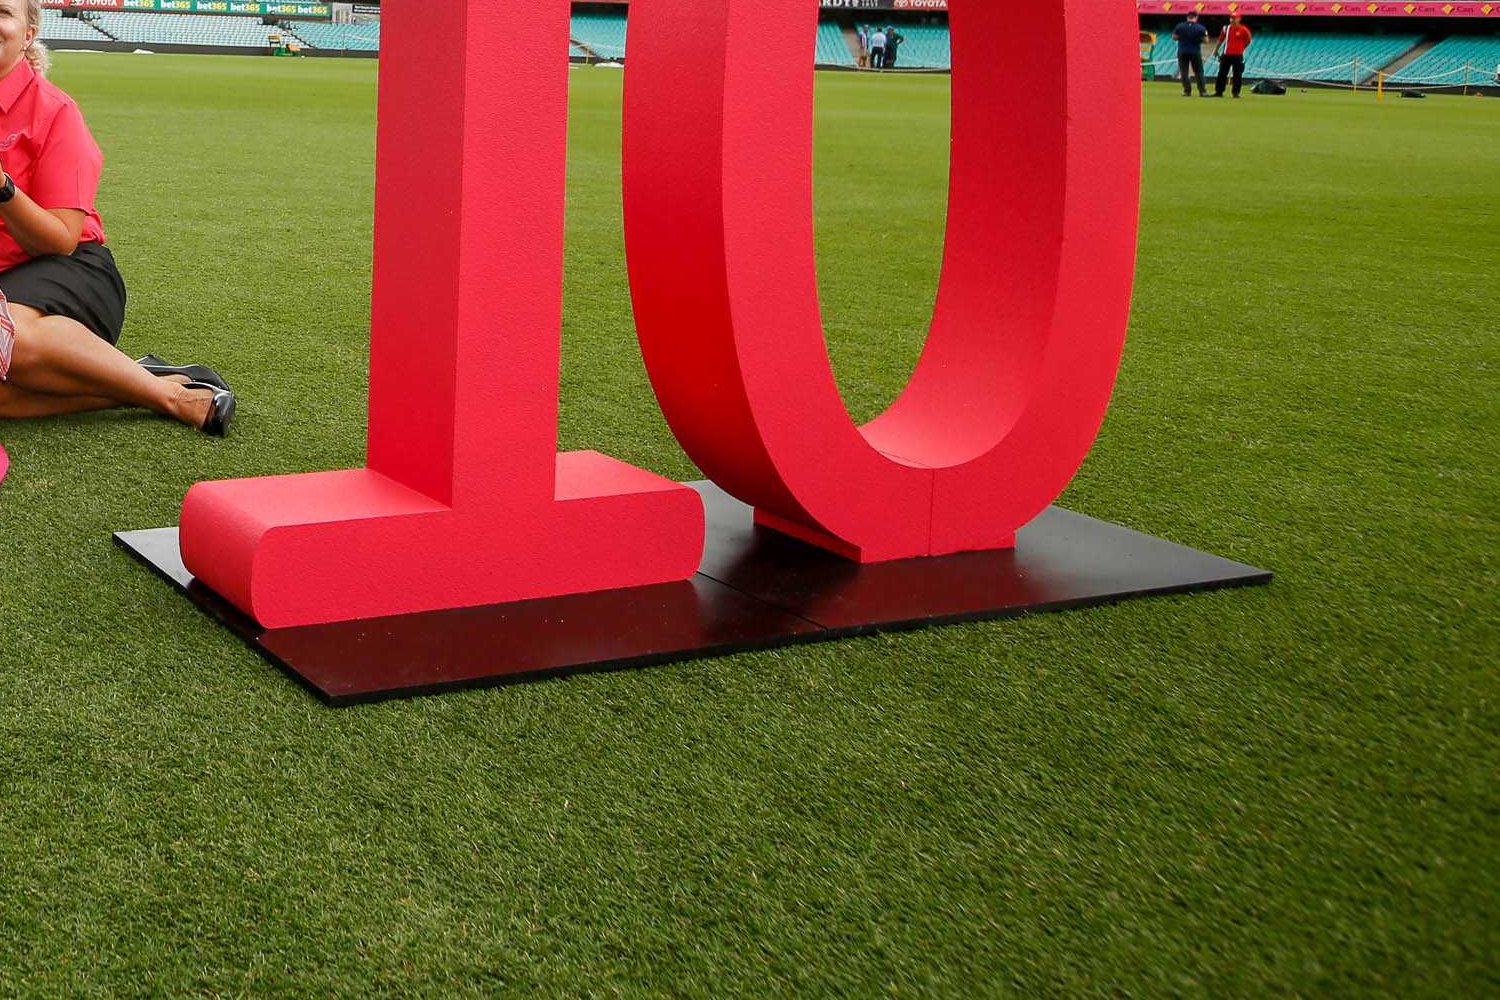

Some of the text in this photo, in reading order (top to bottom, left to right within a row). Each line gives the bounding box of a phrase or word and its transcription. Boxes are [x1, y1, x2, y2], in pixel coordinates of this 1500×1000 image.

[160, 0, 191, 10] bet365
[196, 0, 227, 11] bet365
[230, 1, 260, 12] bet365
[266, 3, 297, 13] bet365
[297, 4, 327, 14] bet365
[909, 0, 947, 7] TOYOTA
